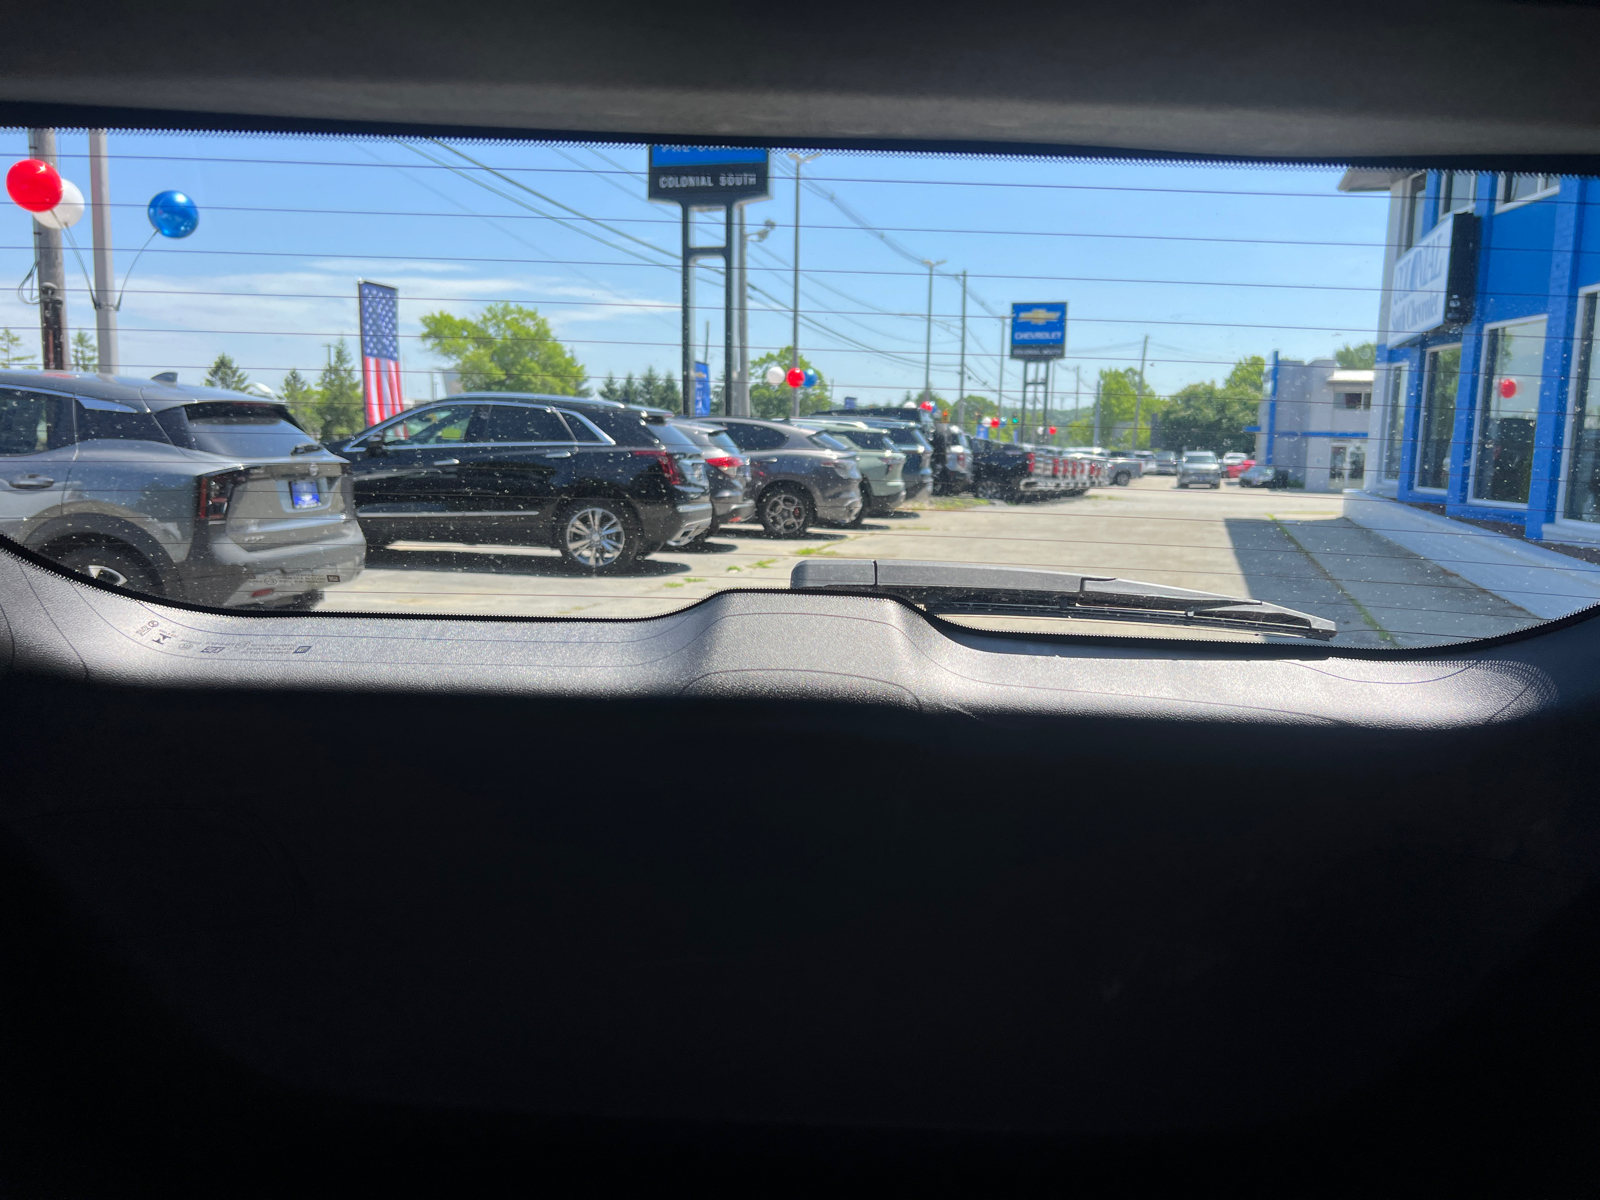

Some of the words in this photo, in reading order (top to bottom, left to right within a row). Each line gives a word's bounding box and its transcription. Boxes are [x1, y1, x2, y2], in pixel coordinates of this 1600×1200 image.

[659, 175, 714, 188] COLONIAL
[719, 173, 757, 187] SOUTH
[1014, 331, 1062, 340] CHEVROLET
